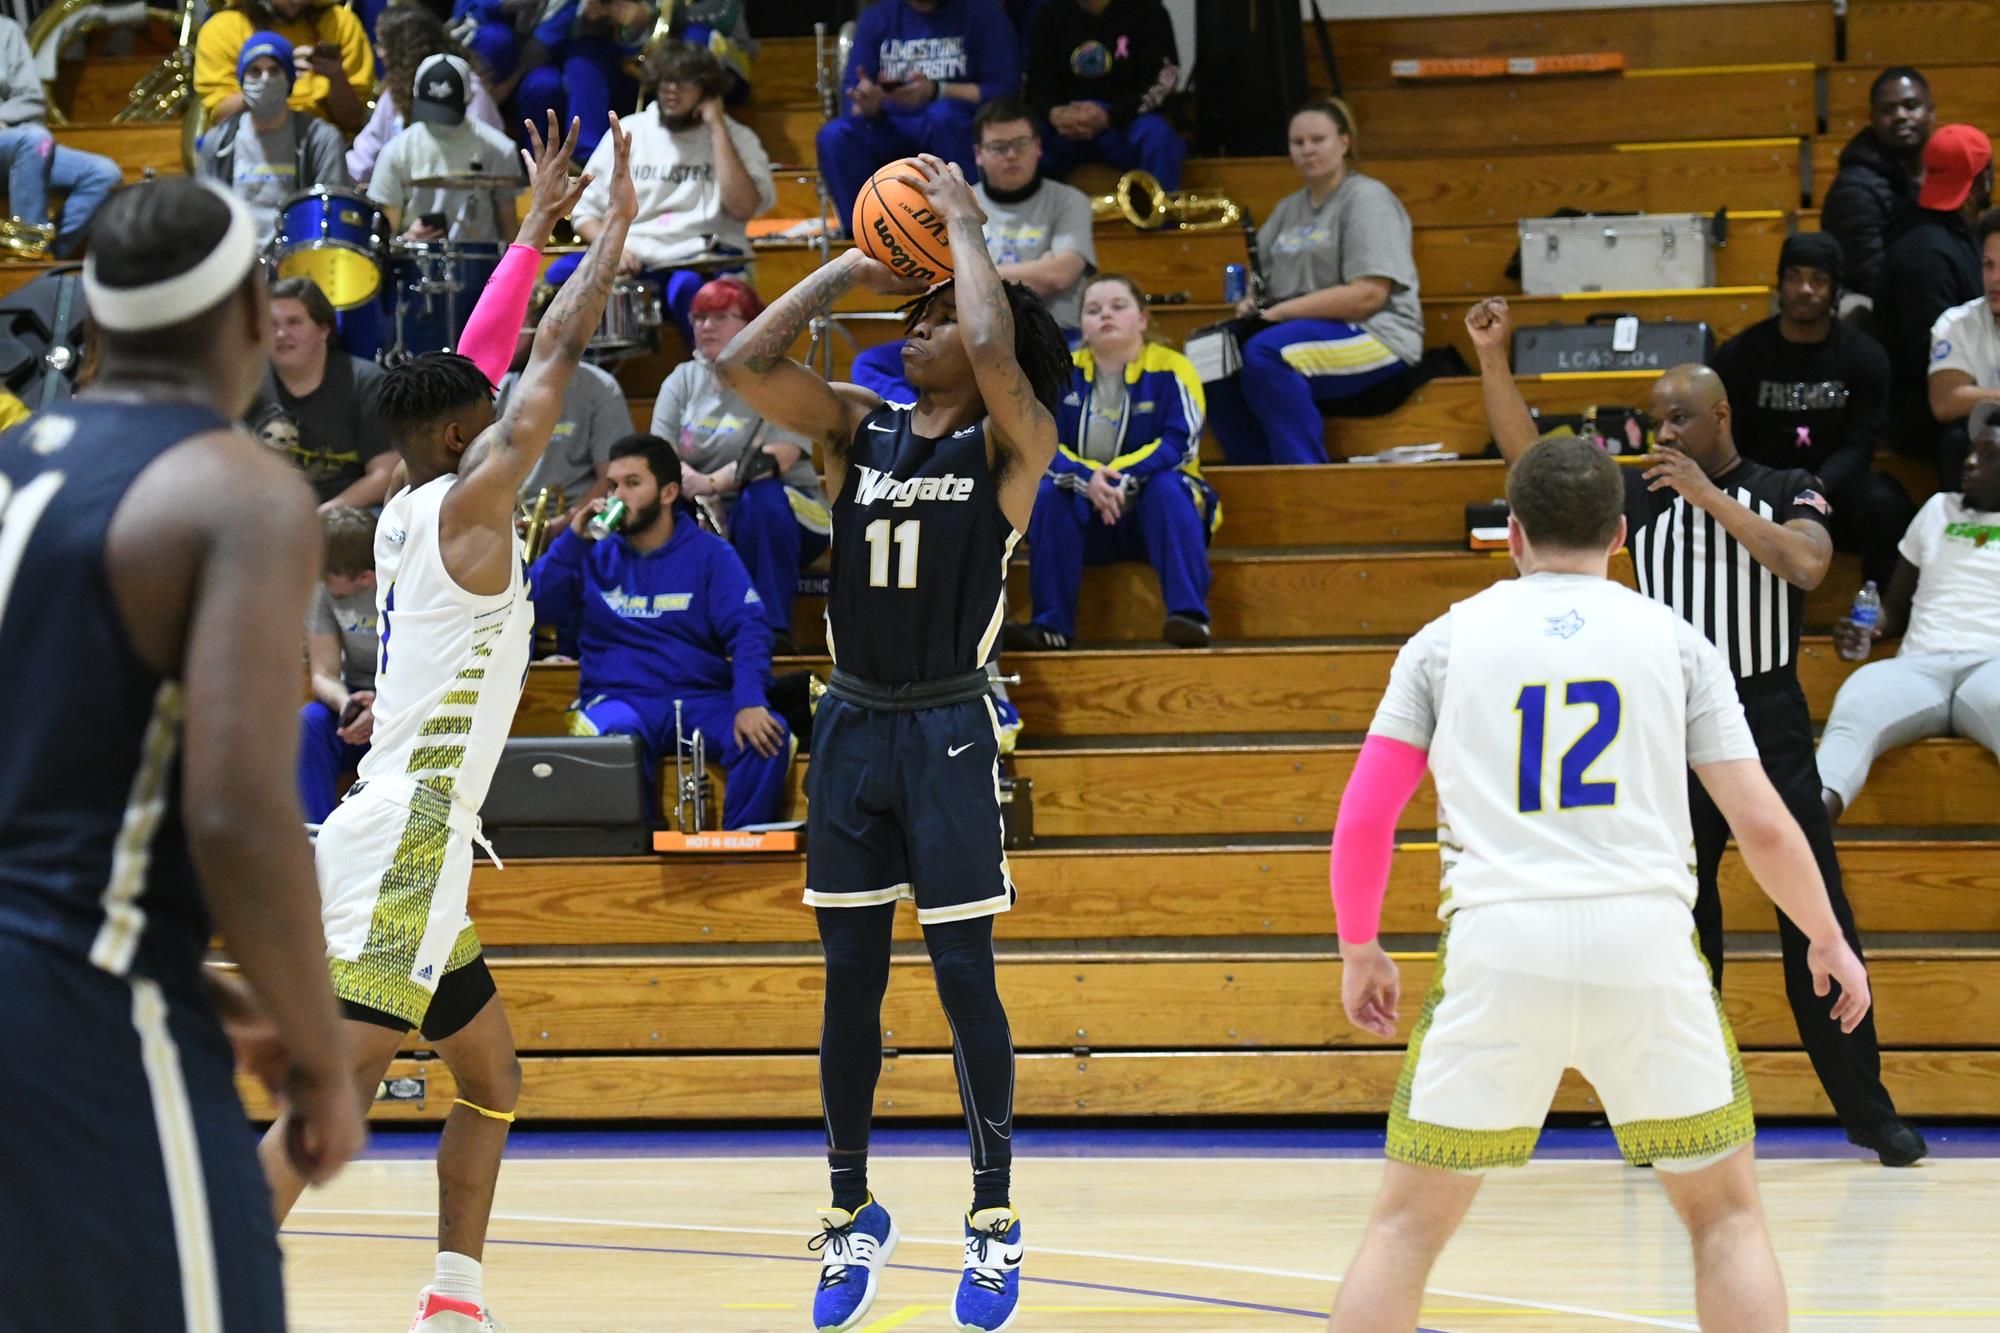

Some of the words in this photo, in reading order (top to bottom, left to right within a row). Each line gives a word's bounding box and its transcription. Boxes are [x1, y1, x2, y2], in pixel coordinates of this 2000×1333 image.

[873, 216, 936, 280] Wilson
[854, 463, 975, 507] Wingate
[865, 518, 921, 589] 11
[1512, 677, 1625, 816] 12
